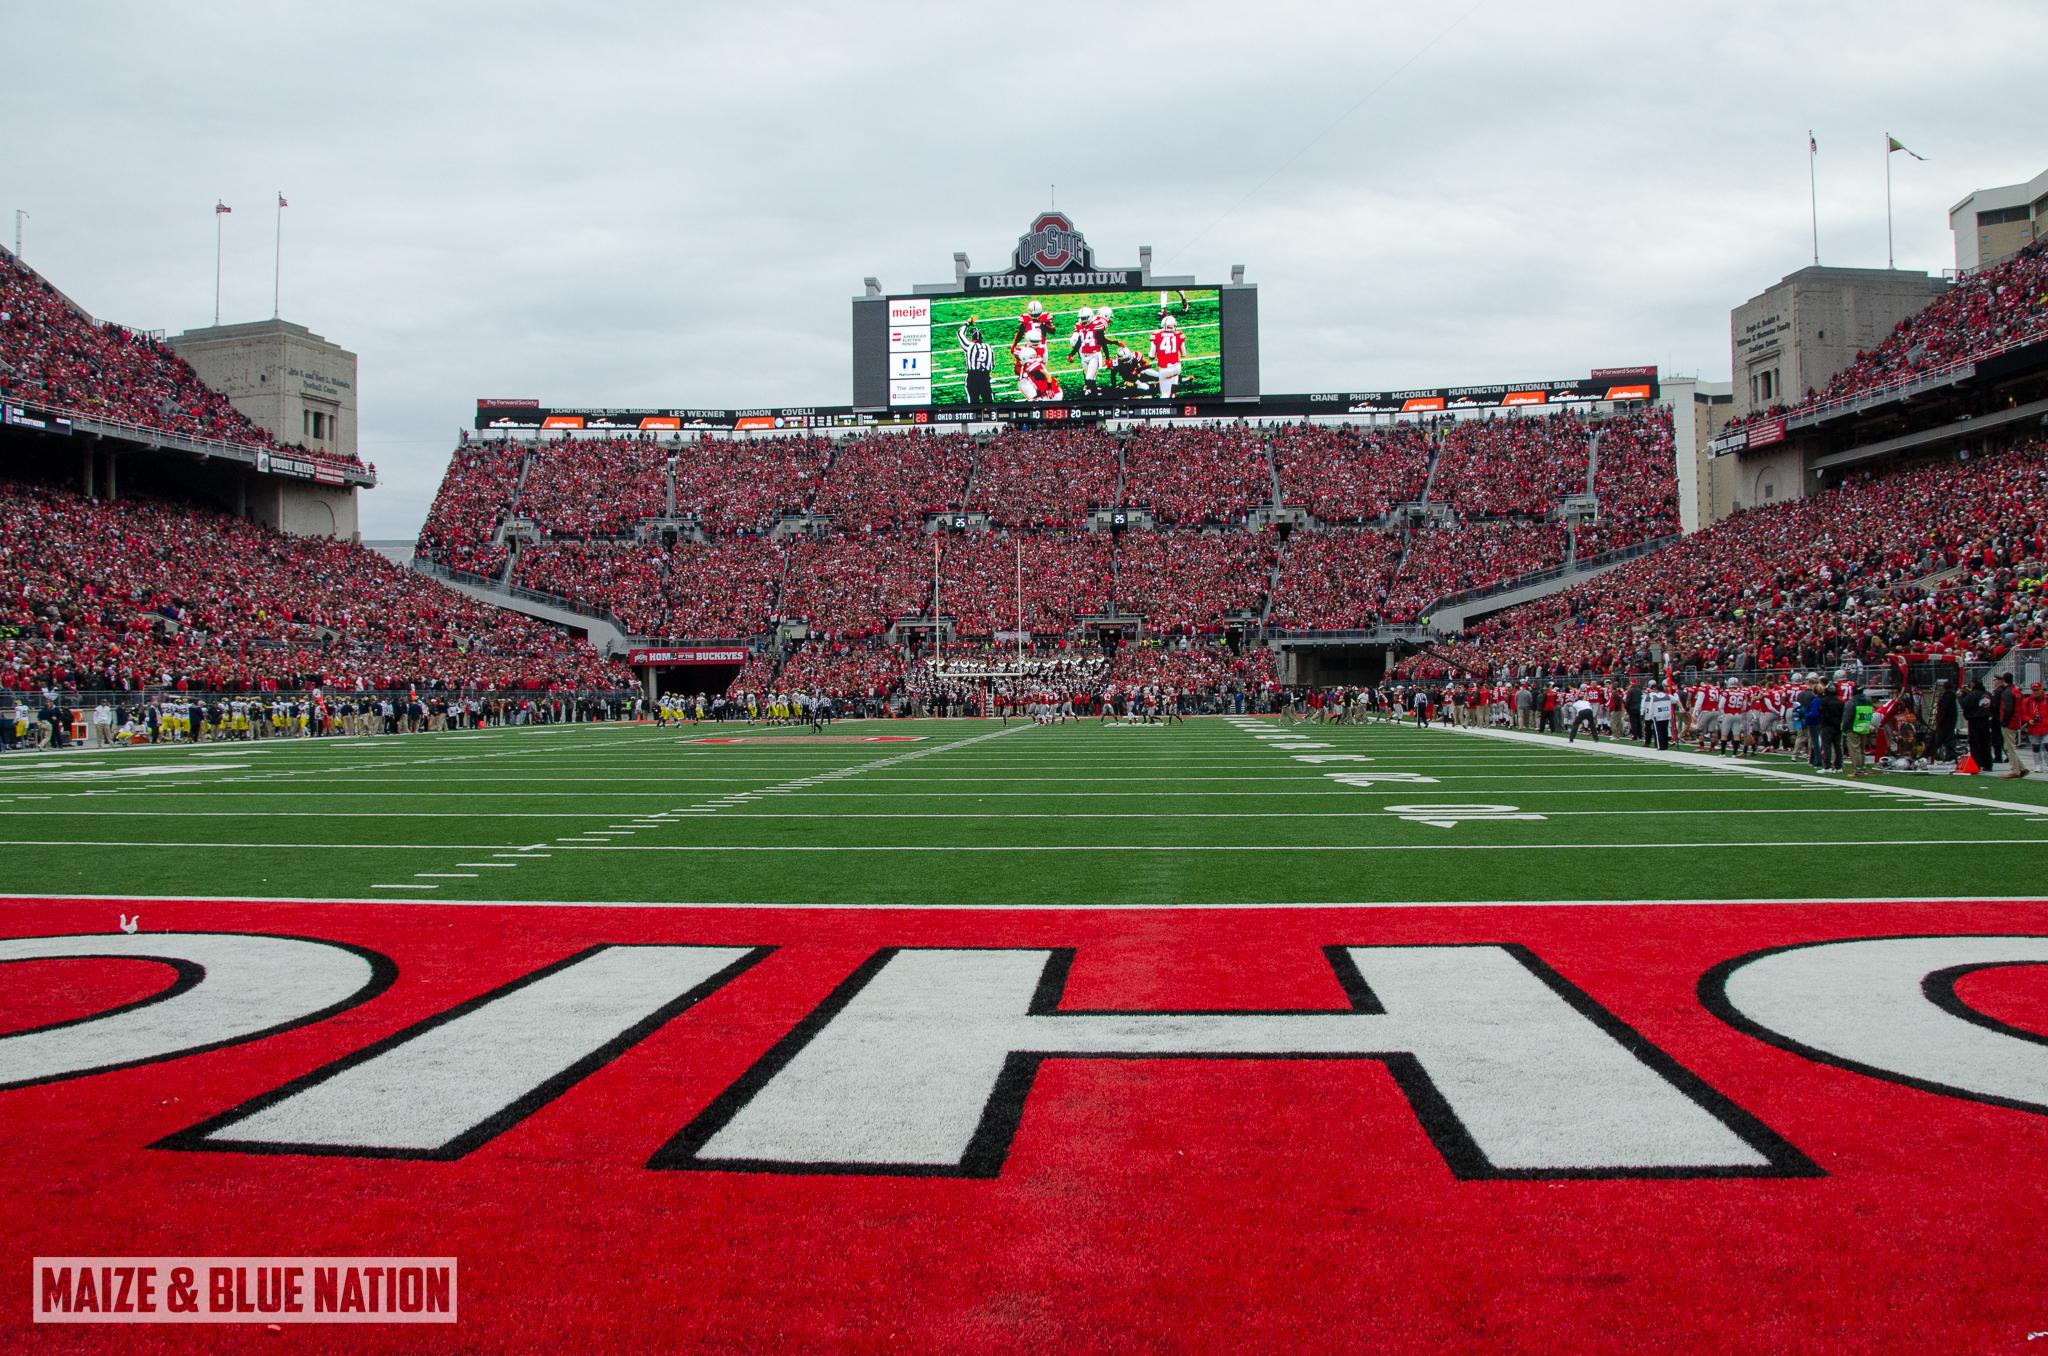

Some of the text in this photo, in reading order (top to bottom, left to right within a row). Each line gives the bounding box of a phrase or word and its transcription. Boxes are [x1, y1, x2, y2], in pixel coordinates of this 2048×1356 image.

[979, 272, 1127, 289] OHIO STADIUM
[892, 306, 927, 319] meijer
[1160, 338, 1176, 354] 41
[1448, 380, 1579, 396] HUNTINGTON NATIONAL BANK
[1392, 390, 1438, 399] McCORKLE
[1448, 400, 1478, 408] Safelite
[1032, 411, 1040, 419] 10
[1045, 409, 1068, 419] 13:31
[1184, 406, 1197, 416] 21
[916, 413, 927, 423] 28
[955, 518, 965, 527] 25
[1115, 515, 1124, 523] 25
[696, 652, 743, 660] BUCKEYES
[1728, 695, 1744, 708] 96
